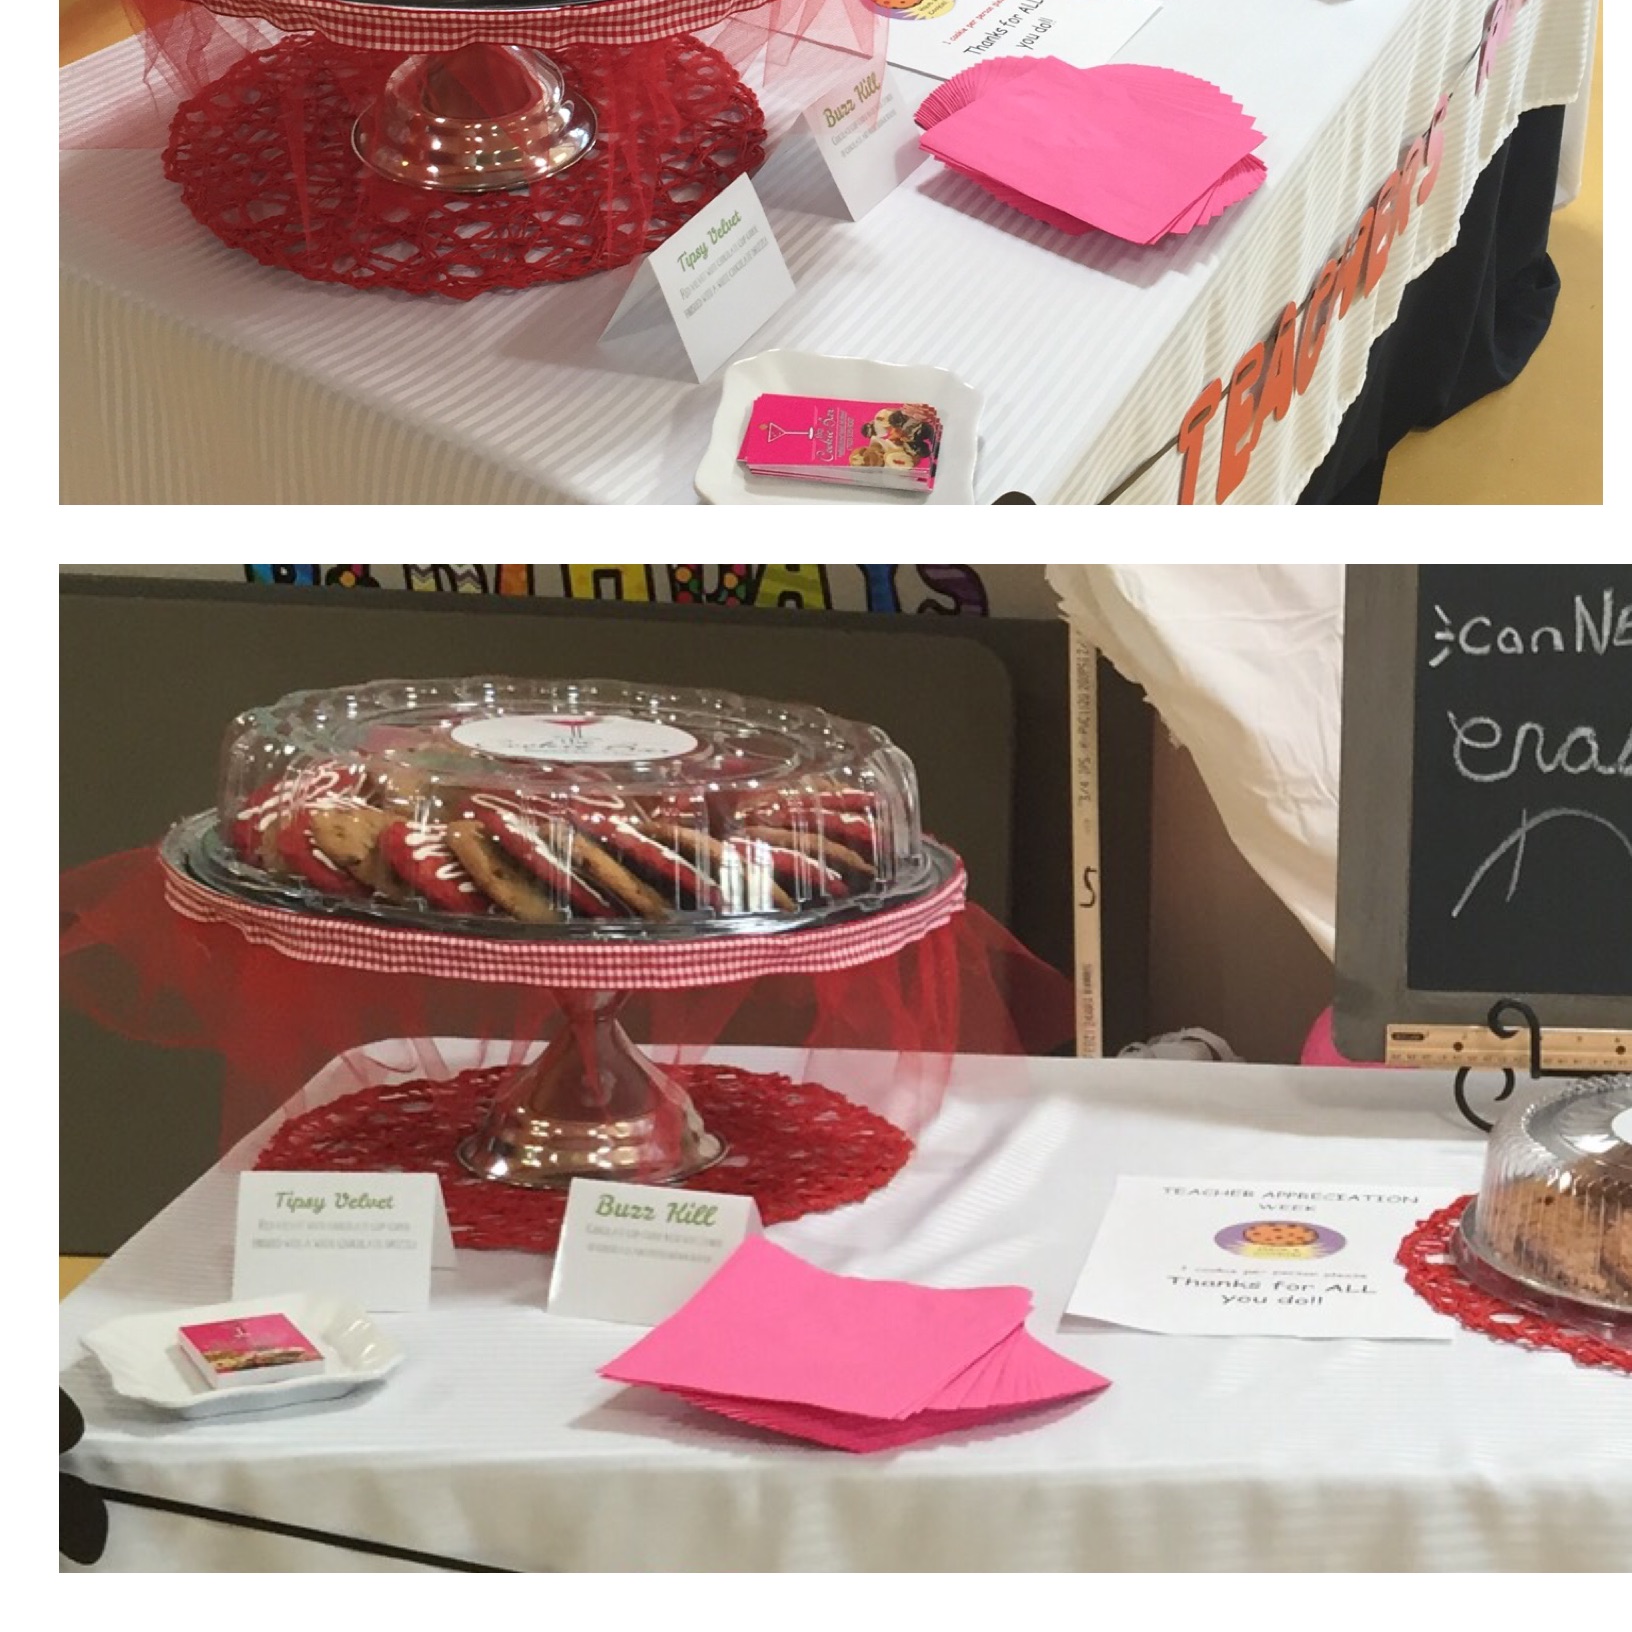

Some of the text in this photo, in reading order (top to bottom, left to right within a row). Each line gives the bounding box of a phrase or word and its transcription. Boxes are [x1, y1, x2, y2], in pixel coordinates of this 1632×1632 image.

[963, 27, 1008, 55] Thanks
[999, 13, 1023, 28] for
[1016, 32, 1040, 50] you
[823, 99, 856, 128] Buzz
[854, 72, 881, 103] Kill
[677, 241, 709, 272] Tipsy
[707, 210, 742, 245] Velvet
[275, 1191, 394, 1215] Tipsy Velvet
[1162, 1186, 1420, 1204] TEACHER APPRECIATION
[595, 1194, 718, 1227] Buzz Kill
[1259, 1203, 1316, 1212] WEEK
[1166, 1275, 1378, 1294] Thanks for ALL
[1221, 1294, 1268, 1306] you
